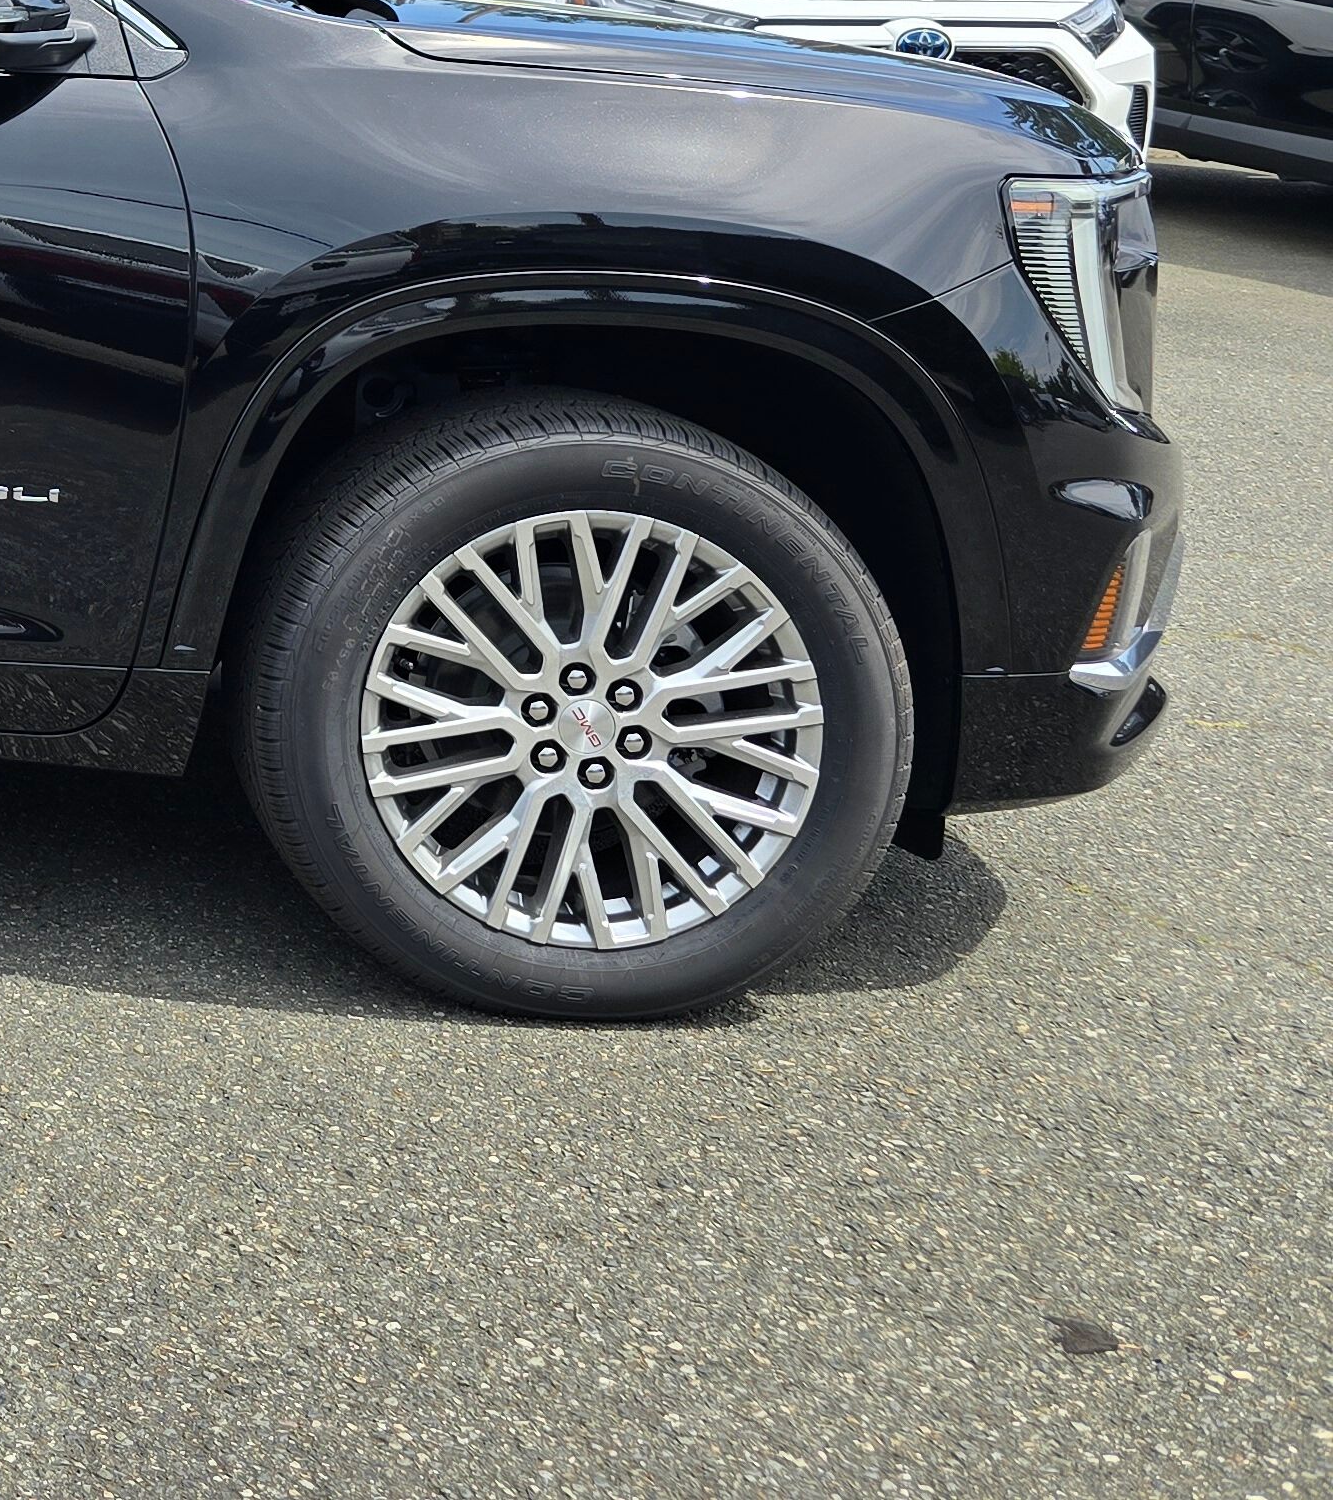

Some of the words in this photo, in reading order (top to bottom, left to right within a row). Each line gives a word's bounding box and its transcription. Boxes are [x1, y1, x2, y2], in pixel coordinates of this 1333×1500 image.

[601, 459, 869, 665] CONTINENTAL
[571, 706, 602, 748] GMC
[326, 803, 597, 1001] CONTINENTAL
